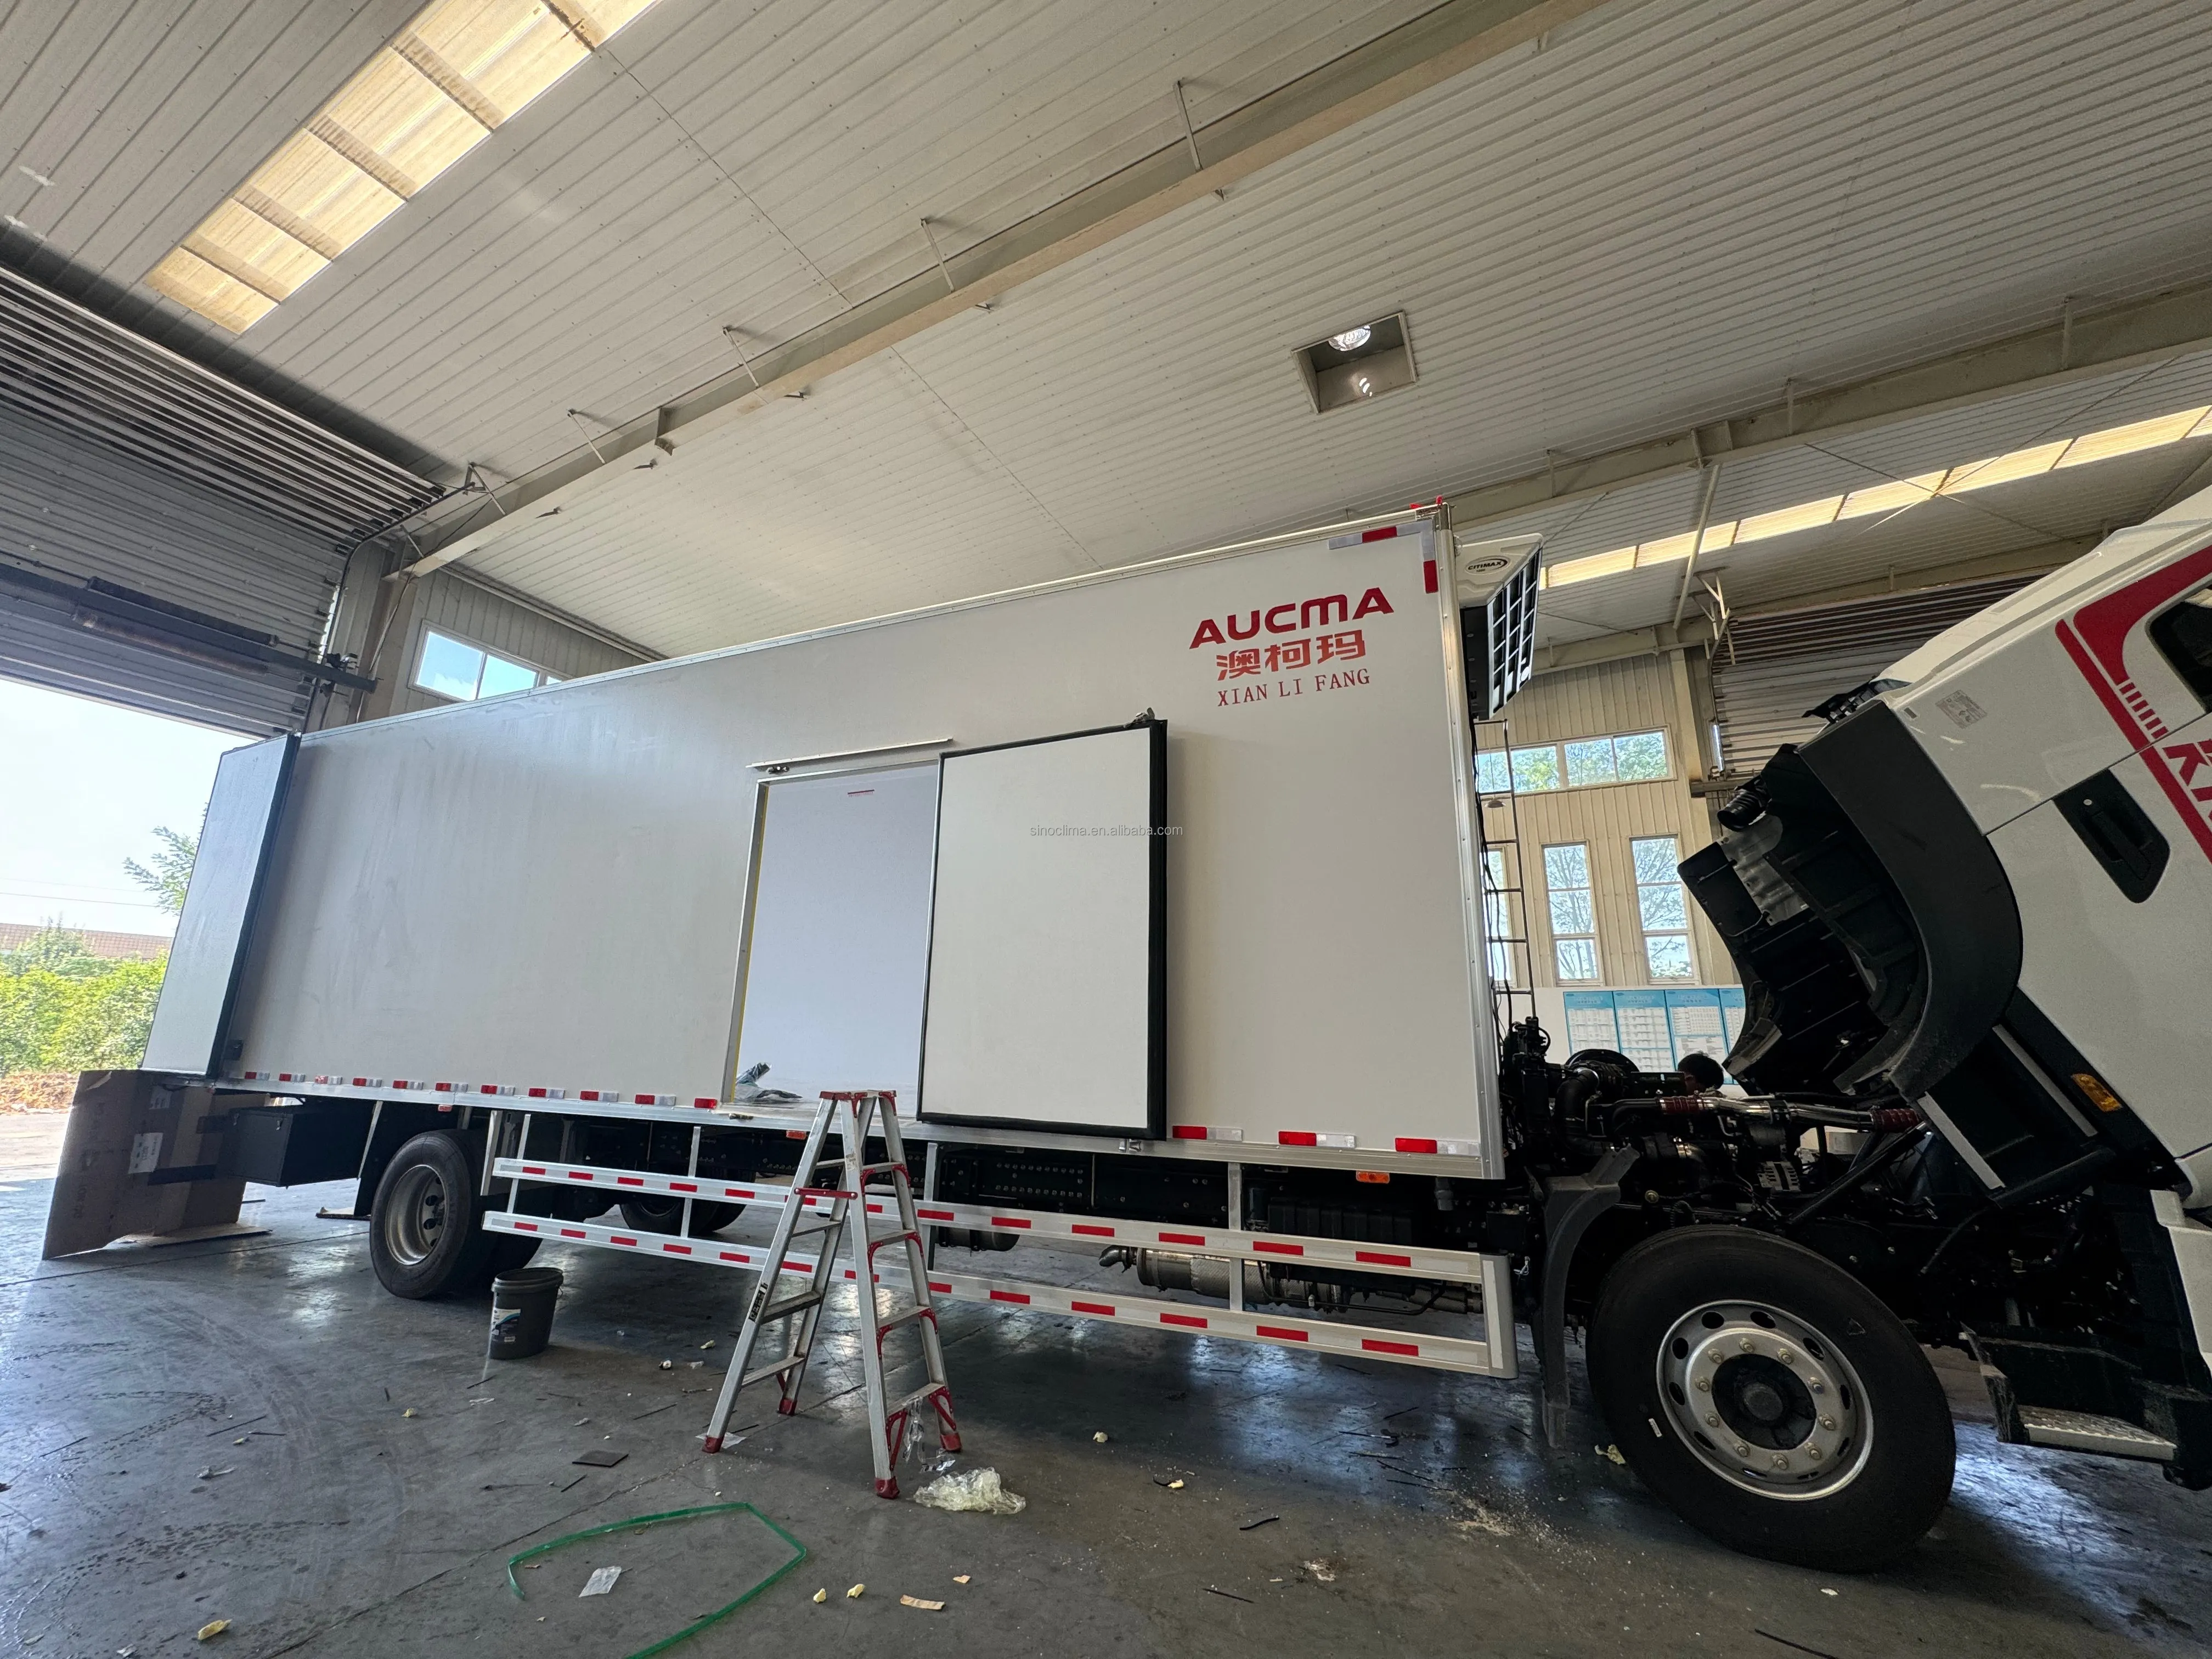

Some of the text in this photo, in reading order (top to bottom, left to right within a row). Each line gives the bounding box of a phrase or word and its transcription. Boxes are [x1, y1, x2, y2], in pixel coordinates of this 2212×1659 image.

[1468, 561, 1502, 570] CITIMAX
[1189, 588, 1394, 650] AUCMA
[1216, 629, 1366, 681] 澳柯玛
[1217, 668, 1370, 707] XIAN LI FANG
